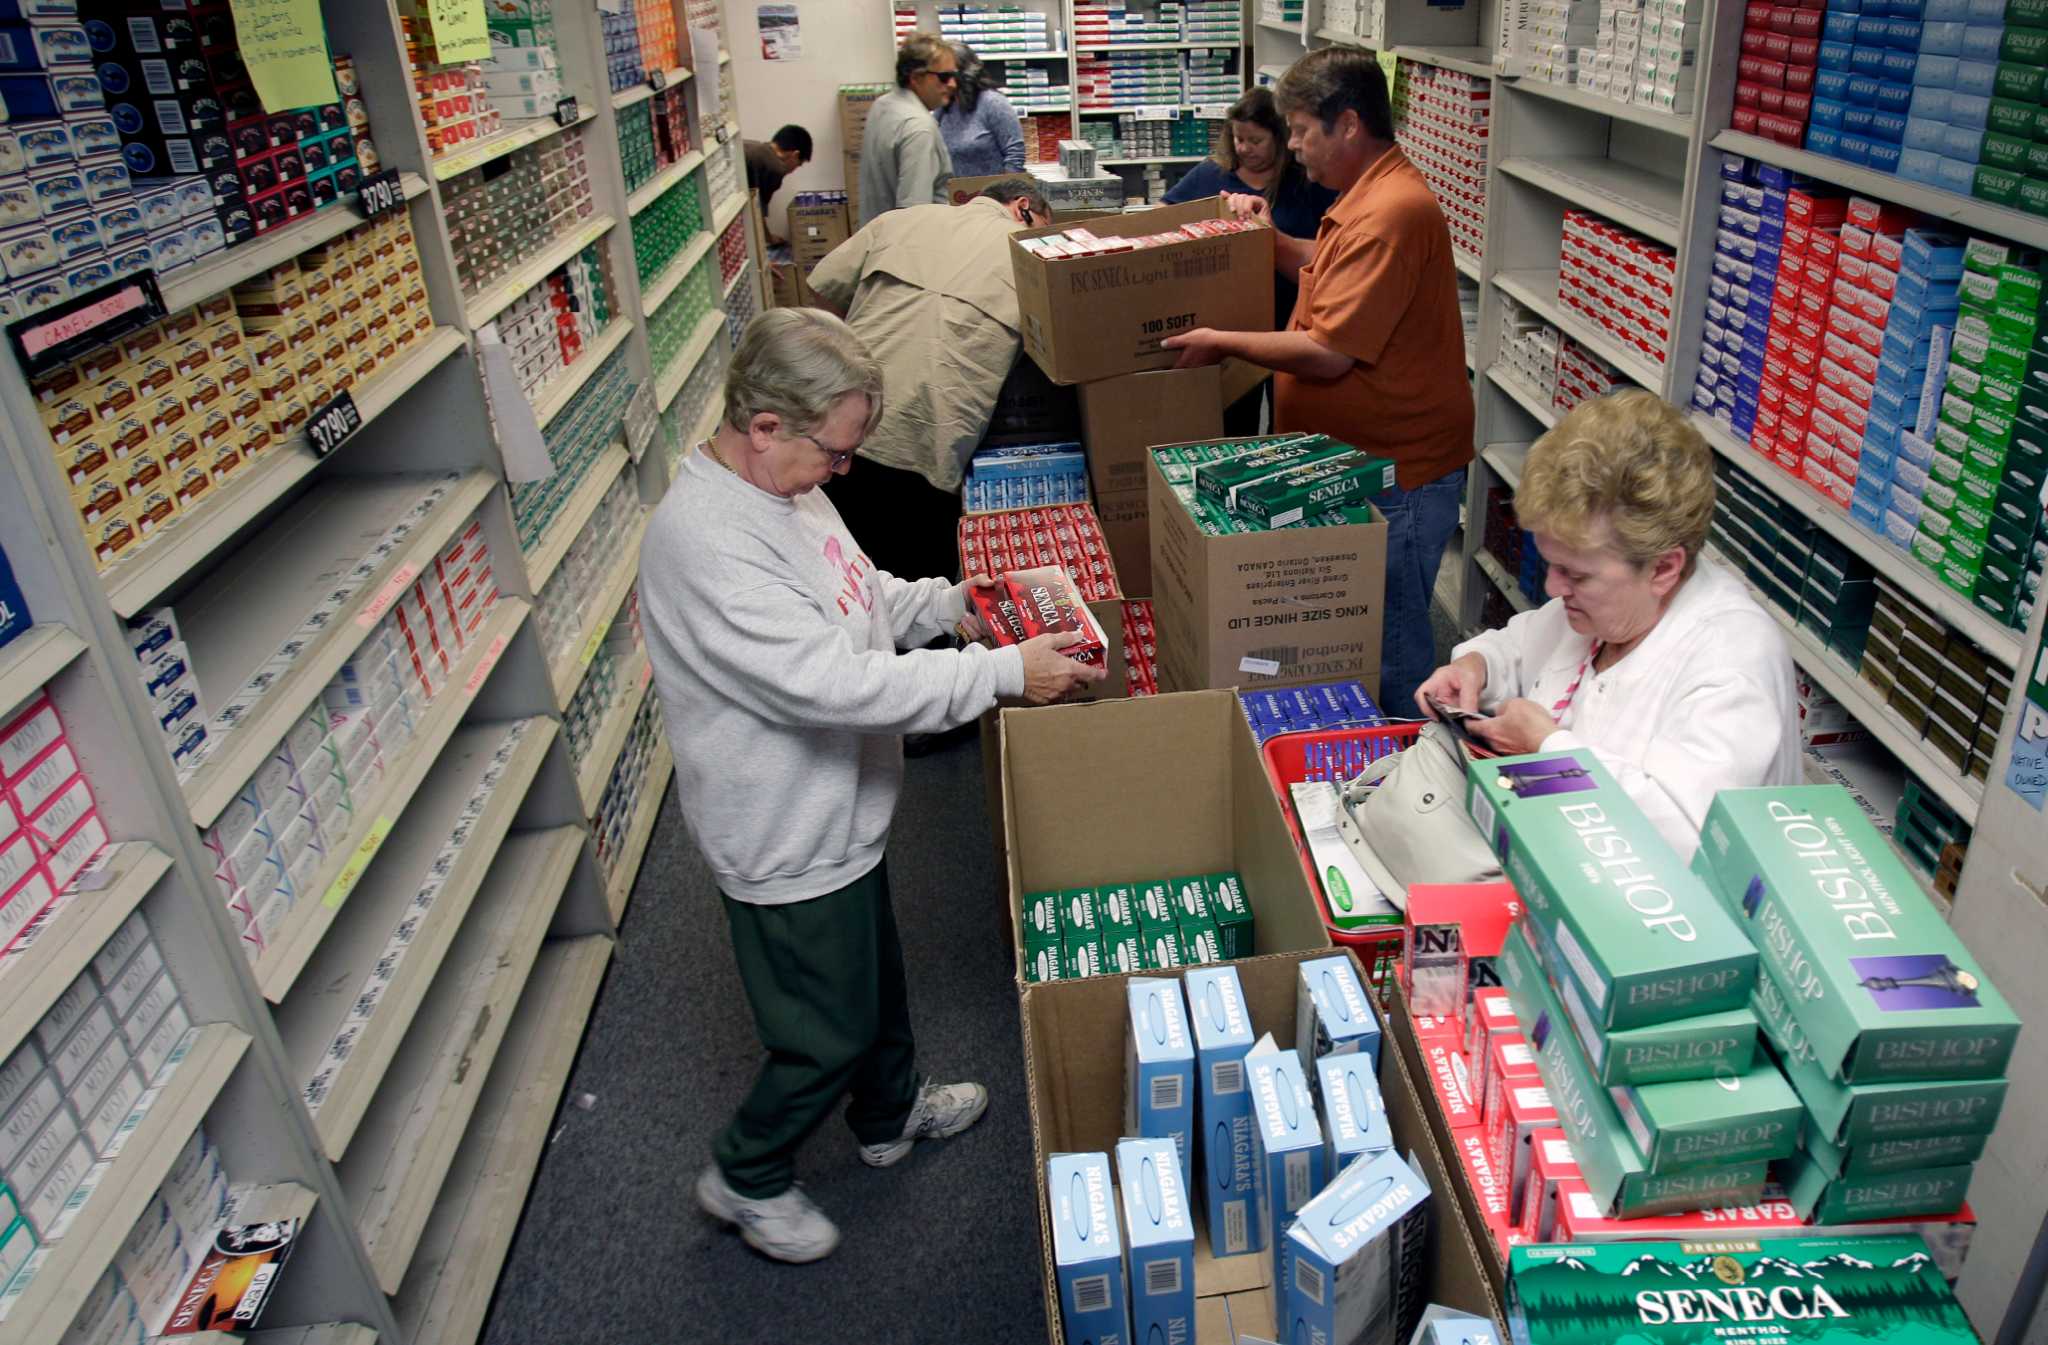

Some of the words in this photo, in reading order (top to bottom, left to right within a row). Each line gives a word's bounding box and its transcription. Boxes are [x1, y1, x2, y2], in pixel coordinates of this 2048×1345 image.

[1518, 1, 1528, 30] MERI
[2007, 32, 2046, 48] BISHOP
[2001, 69, 2038, 86] BISHOP
[1993, 104, 2031, 121] BISHOP
[1987, 138, 2023, 154] BISHOP
[1978, 172, 2015, 189] BISHOP
[1091, 265, 1130, 291] SENECA
[1132, 271, 1168, 285] Light
[1141, 319, 1163, 334] 100
[1166, 313, 1196, 330] SOFT
[1246, 448, 1310, 467] SENECA
[1308, 477, 1360, 504] SENECA
[1238, 560, 1274, 571] CANADA
[1031, 586, 1060, 627] SENECA
[1228, 617, 1250, 629] LID
[1255, 613, 1298, 627] HINGE
[1302, 609, 1331, 622] SIZE
[1335, 605, 1368, 618] KING
[1302, 641, 1364, 658] Menthol
[1559, 802, 1697, 941] BISHOP
[1767, 800, 1897, 940] BISHOP
[1117, 889, 1134, 926] NIAGARA'S
[1153, 886, 1171, 922] NIAGARA'S
[1190, 881, 1208, 918] NIAGARA'S
[1227, 877, 1246, 914] NIAGARA'S
[1861, 866, 1902, 914] MENTHOL
[1045, 896, 1056, 934] NIAGARA'S
[1081, 893, 1095, 930] NIAGARA'S
[1760, 901, 1824, 1000] BISHOP
[1218, 975, 1245, 1035] NIAGARA'S
[1332, 965, 1367, 1024] NIAGARA'S
[1629, 970, 1738, 1005] BISHOP
[1161, 988, 1184, 1048] NIAGARA'S
[1625, 1039, 1738, 1065] BISHOP
[1875, 1038, 1997, 1060] BISHOP
[1430, 1047, 1467, 1115] NIAGARA'S
[1546, 1039, 1596, 1138] BISHOP
[1256, 1065, 1287, 1138] NIAGARA'S
[1328, 1068, 1356, 1140] NIAGARA'S
[1869, 1097, 1986, 1123] BISHOP
[1232, 1117, 1250, 1192] NIAGARA'S
[1674, 1122, 1782, 1155] BISHOP
[1155, 1152, 1183, 1229] NIAGARA'S
[1464, 1137, 1505, 1214] NIAGARA'S
[1642, 1173, 1750, 1198] BISHOP
[1845, 1180, 1954, 1204] BISHOP
[1087, 1166, 1110, 1244] NIAGARA'S
[1333, 1184, 1413, 1249] NIAGARA'S
[1702, 1203, 1796, 1221] GARA'S
[1682, 1241, 1760, 1253] PREMIUM
[173, 1257, 229, 1328] SENECA
[1636, 1284, 1851, 1325] SENECA
[1714, 1326, 1791, 1337] MENTHOL
